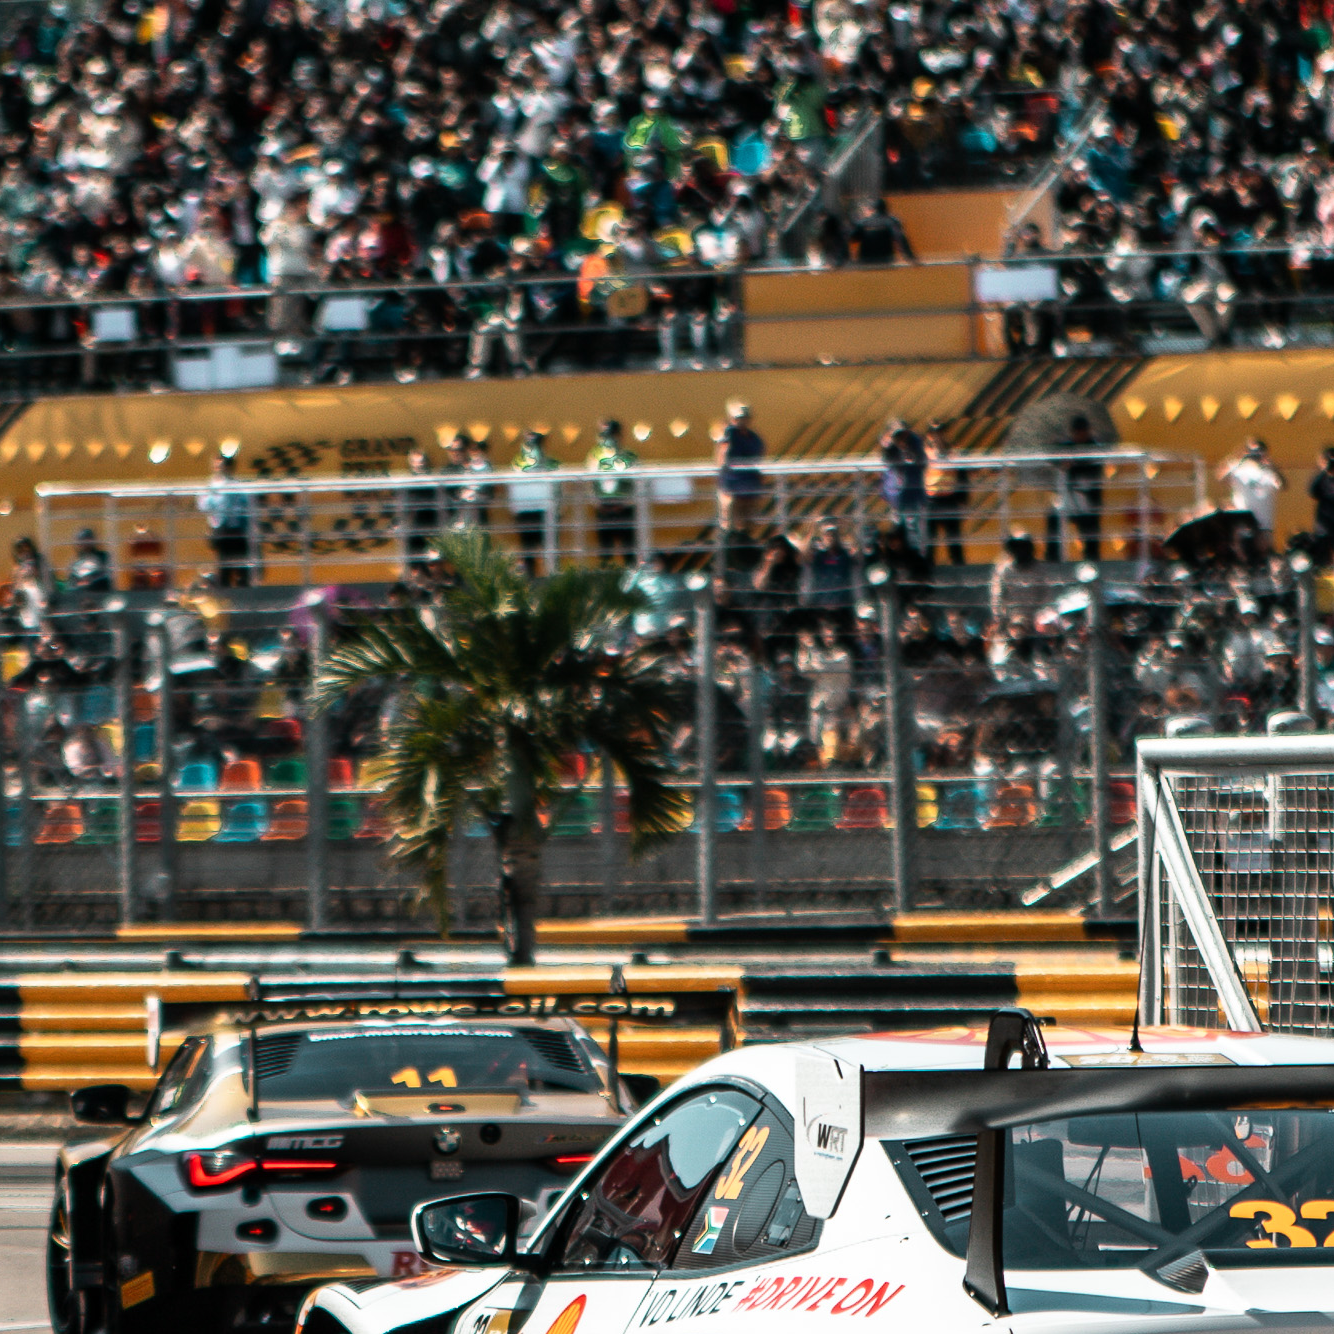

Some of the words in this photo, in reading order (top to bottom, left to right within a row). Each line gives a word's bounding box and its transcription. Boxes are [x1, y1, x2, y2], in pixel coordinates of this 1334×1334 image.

[390, 1065, 459, 1088] 11
[715, 1126, 770, 1200] 32
[731, 1275, 849, 1313] #DRIVE
[830, 1278, 906, 1318] ON
